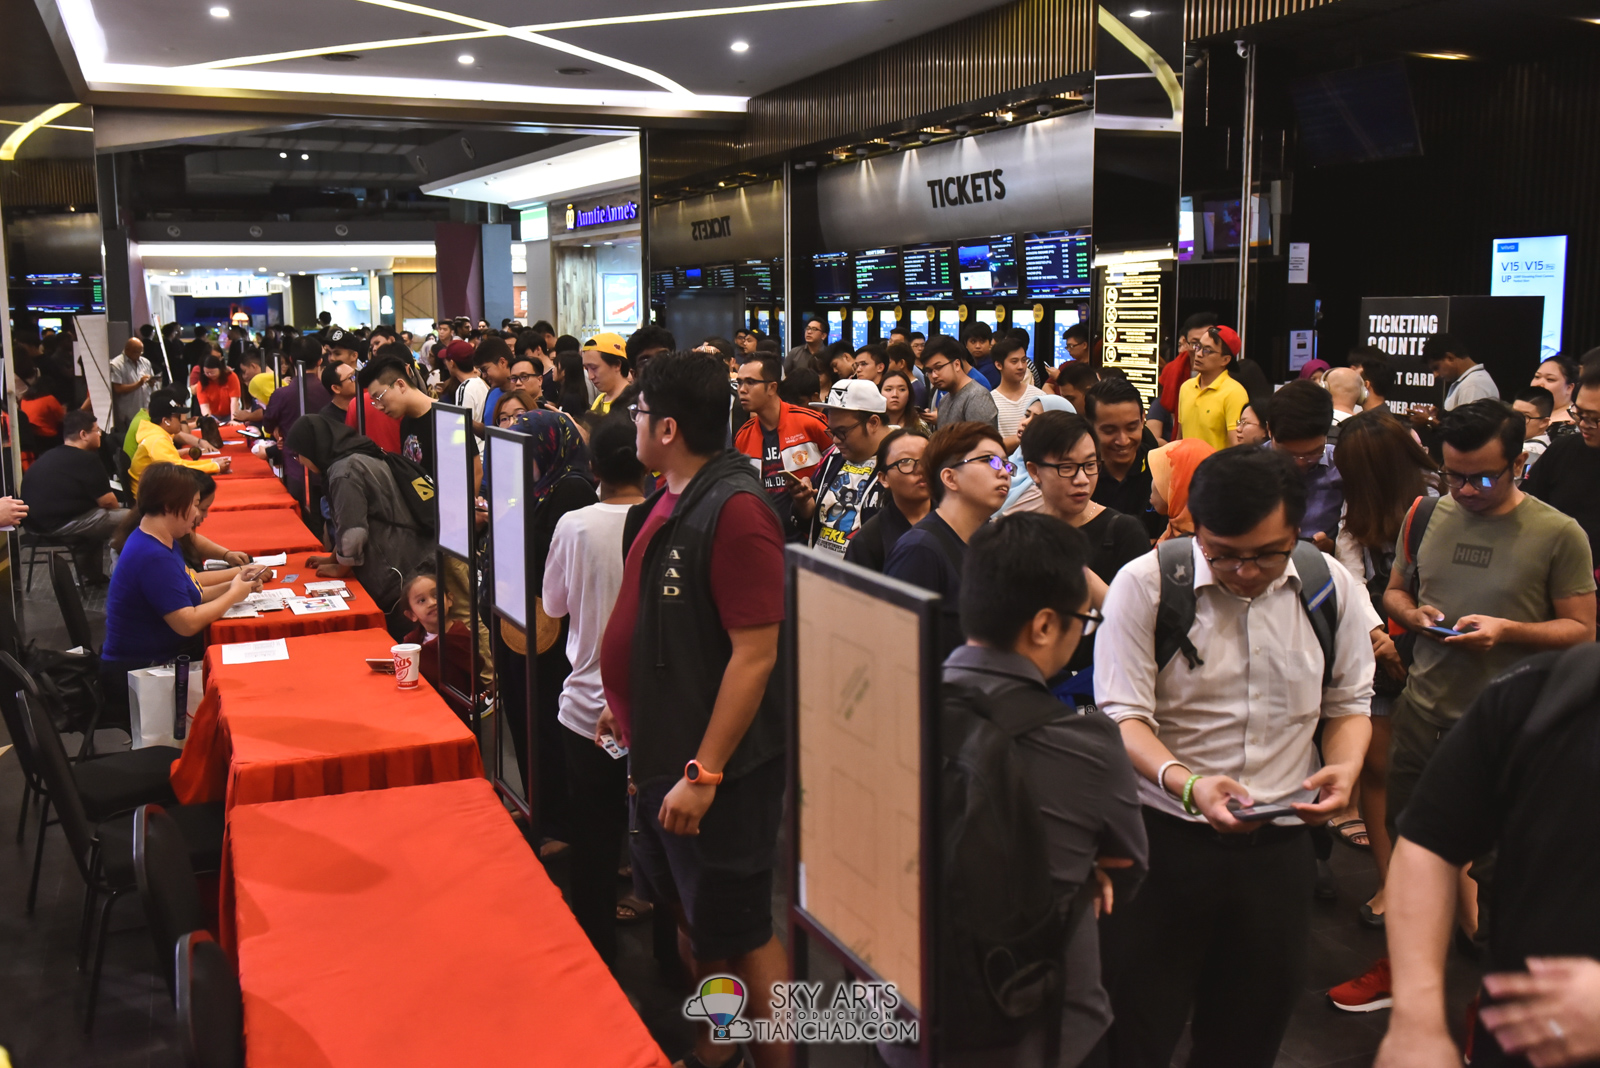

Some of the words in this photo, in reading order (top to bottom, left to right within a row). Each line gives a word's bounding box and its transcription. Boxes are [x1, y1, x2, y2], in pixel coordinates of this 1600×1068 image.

[927, 169, 1006, 208] TICKETS
[577, 205, 605, 227] Auntie
[605, 201, 637, 223] Anne's
[1501, 261, 1519, 271] V15
[1525, 260, 1544, 271] V15
[1501, 275, 1512, 283] UP
[1369, 315, 1438, 334] TICKETING
[1368, 336, 1429, 356] COUNTE
[1405, 372, 1435, 387] CARD
[1455, 547, 1492, 565] HIGH
